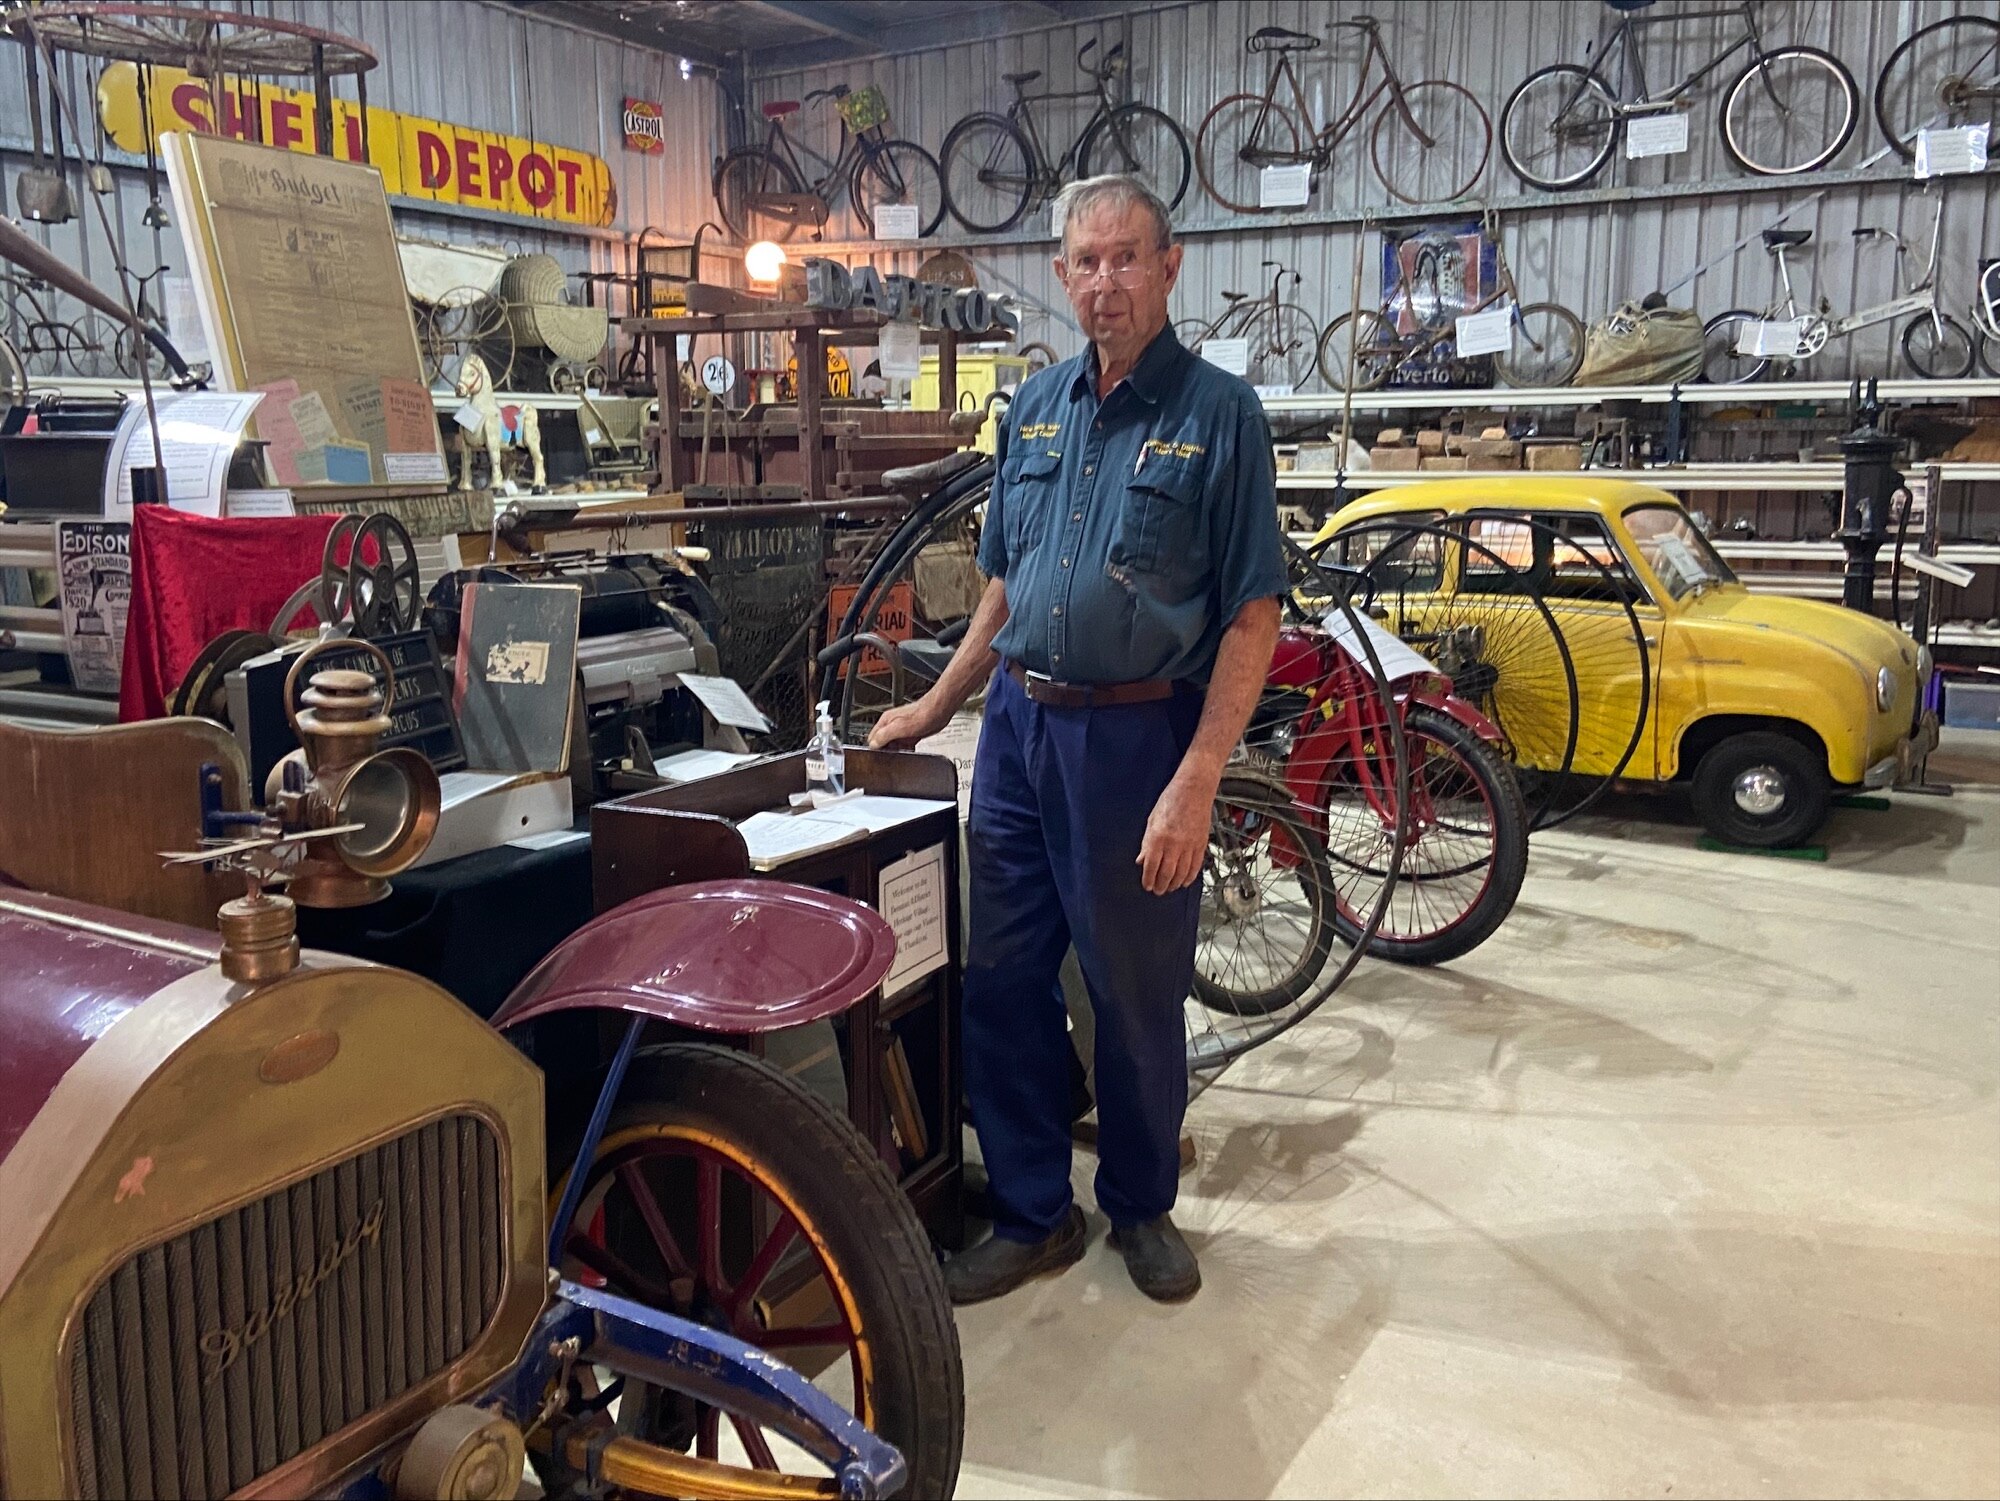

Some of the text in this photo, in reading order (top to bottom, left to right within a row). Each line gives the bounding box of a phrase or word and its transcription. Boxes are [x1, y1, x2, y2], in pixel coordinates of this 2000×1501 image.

[625, 111, 663, 142] CASTROL
[171, 84, 582, 214] SHEL DEPOT
[270, 167, 341, 206] Budget
[83, 525, 104, 533] THE
[62, 530, 130, 555] EDISON
[91, 556, 129, 570] STANDARD
[391, 646, 405, 666] OF
